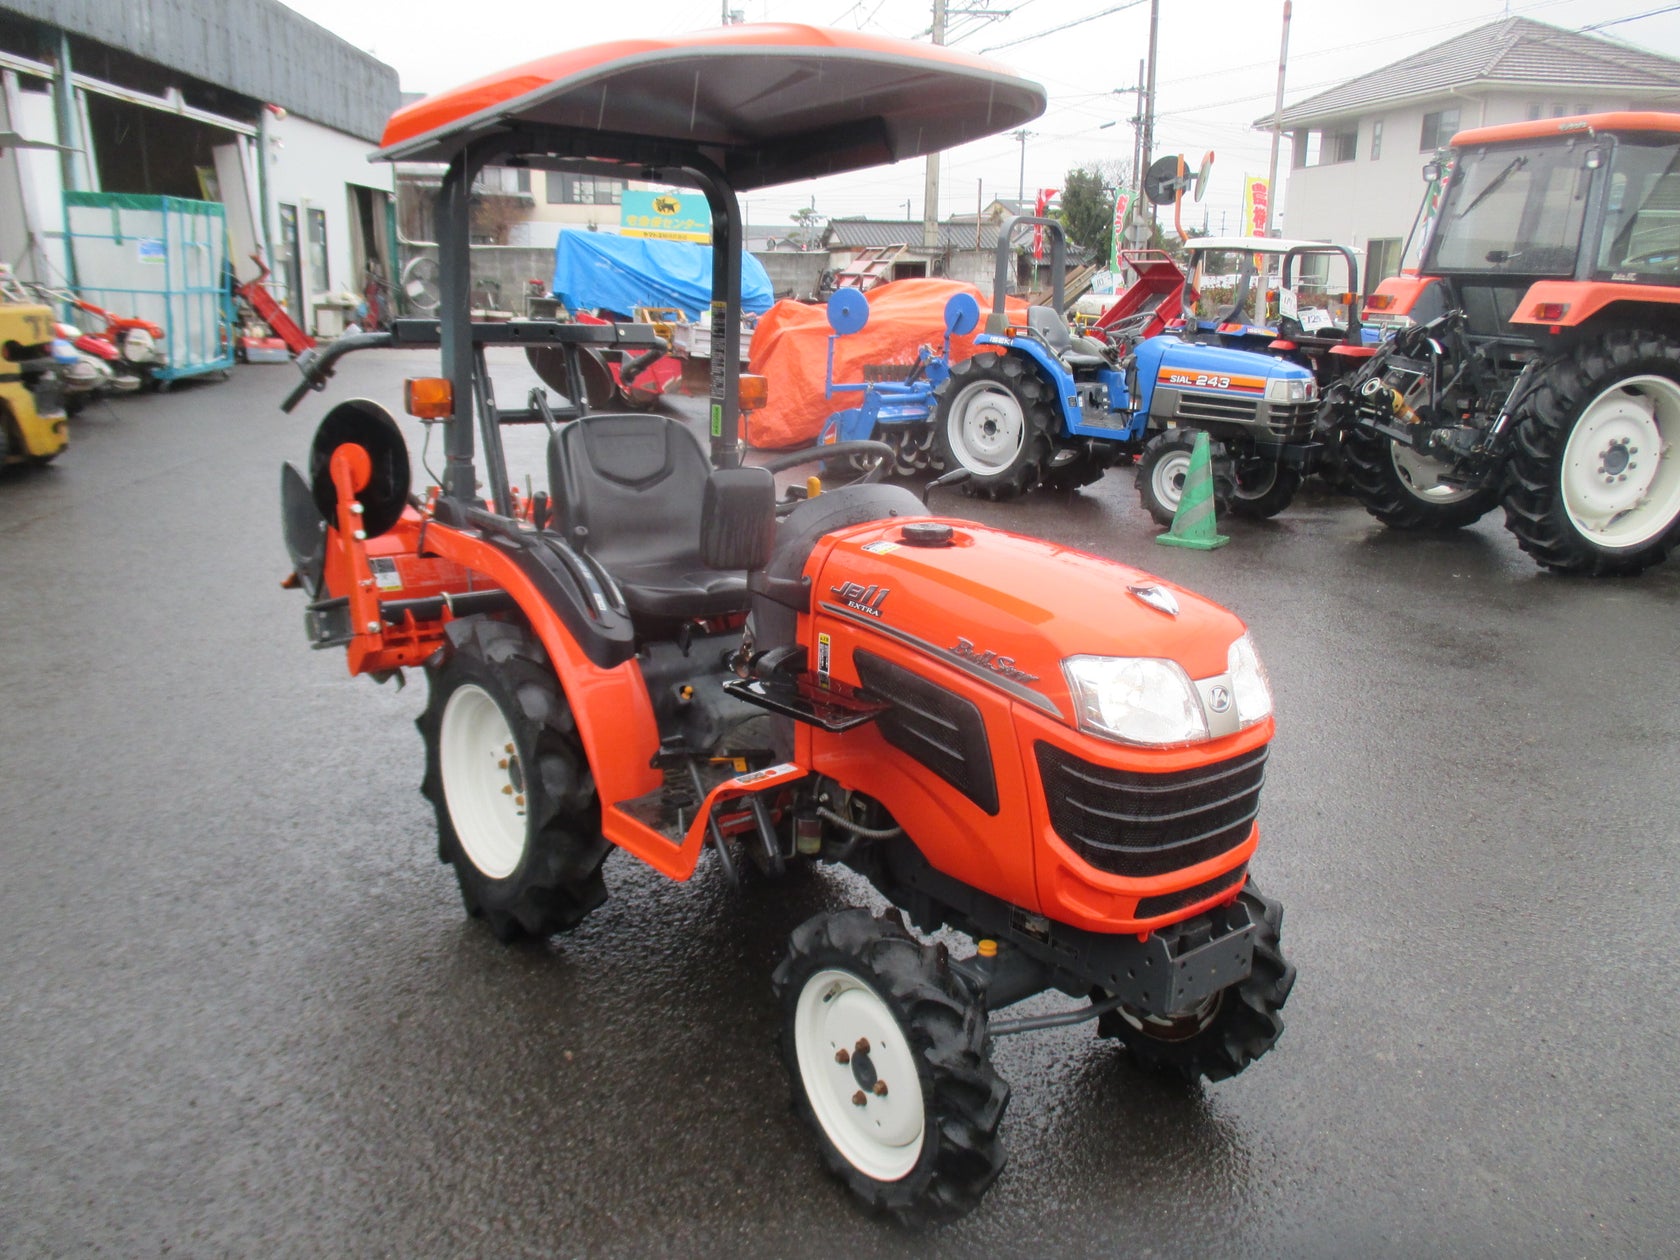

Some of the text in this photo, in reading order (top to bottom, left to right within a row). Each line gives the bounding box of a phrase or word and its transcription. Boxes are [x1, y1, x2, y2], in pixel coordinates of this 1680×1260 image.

[1169, 374, 1231, 389] SIAL 243
[847, 600, 880, 617] EXTRA
